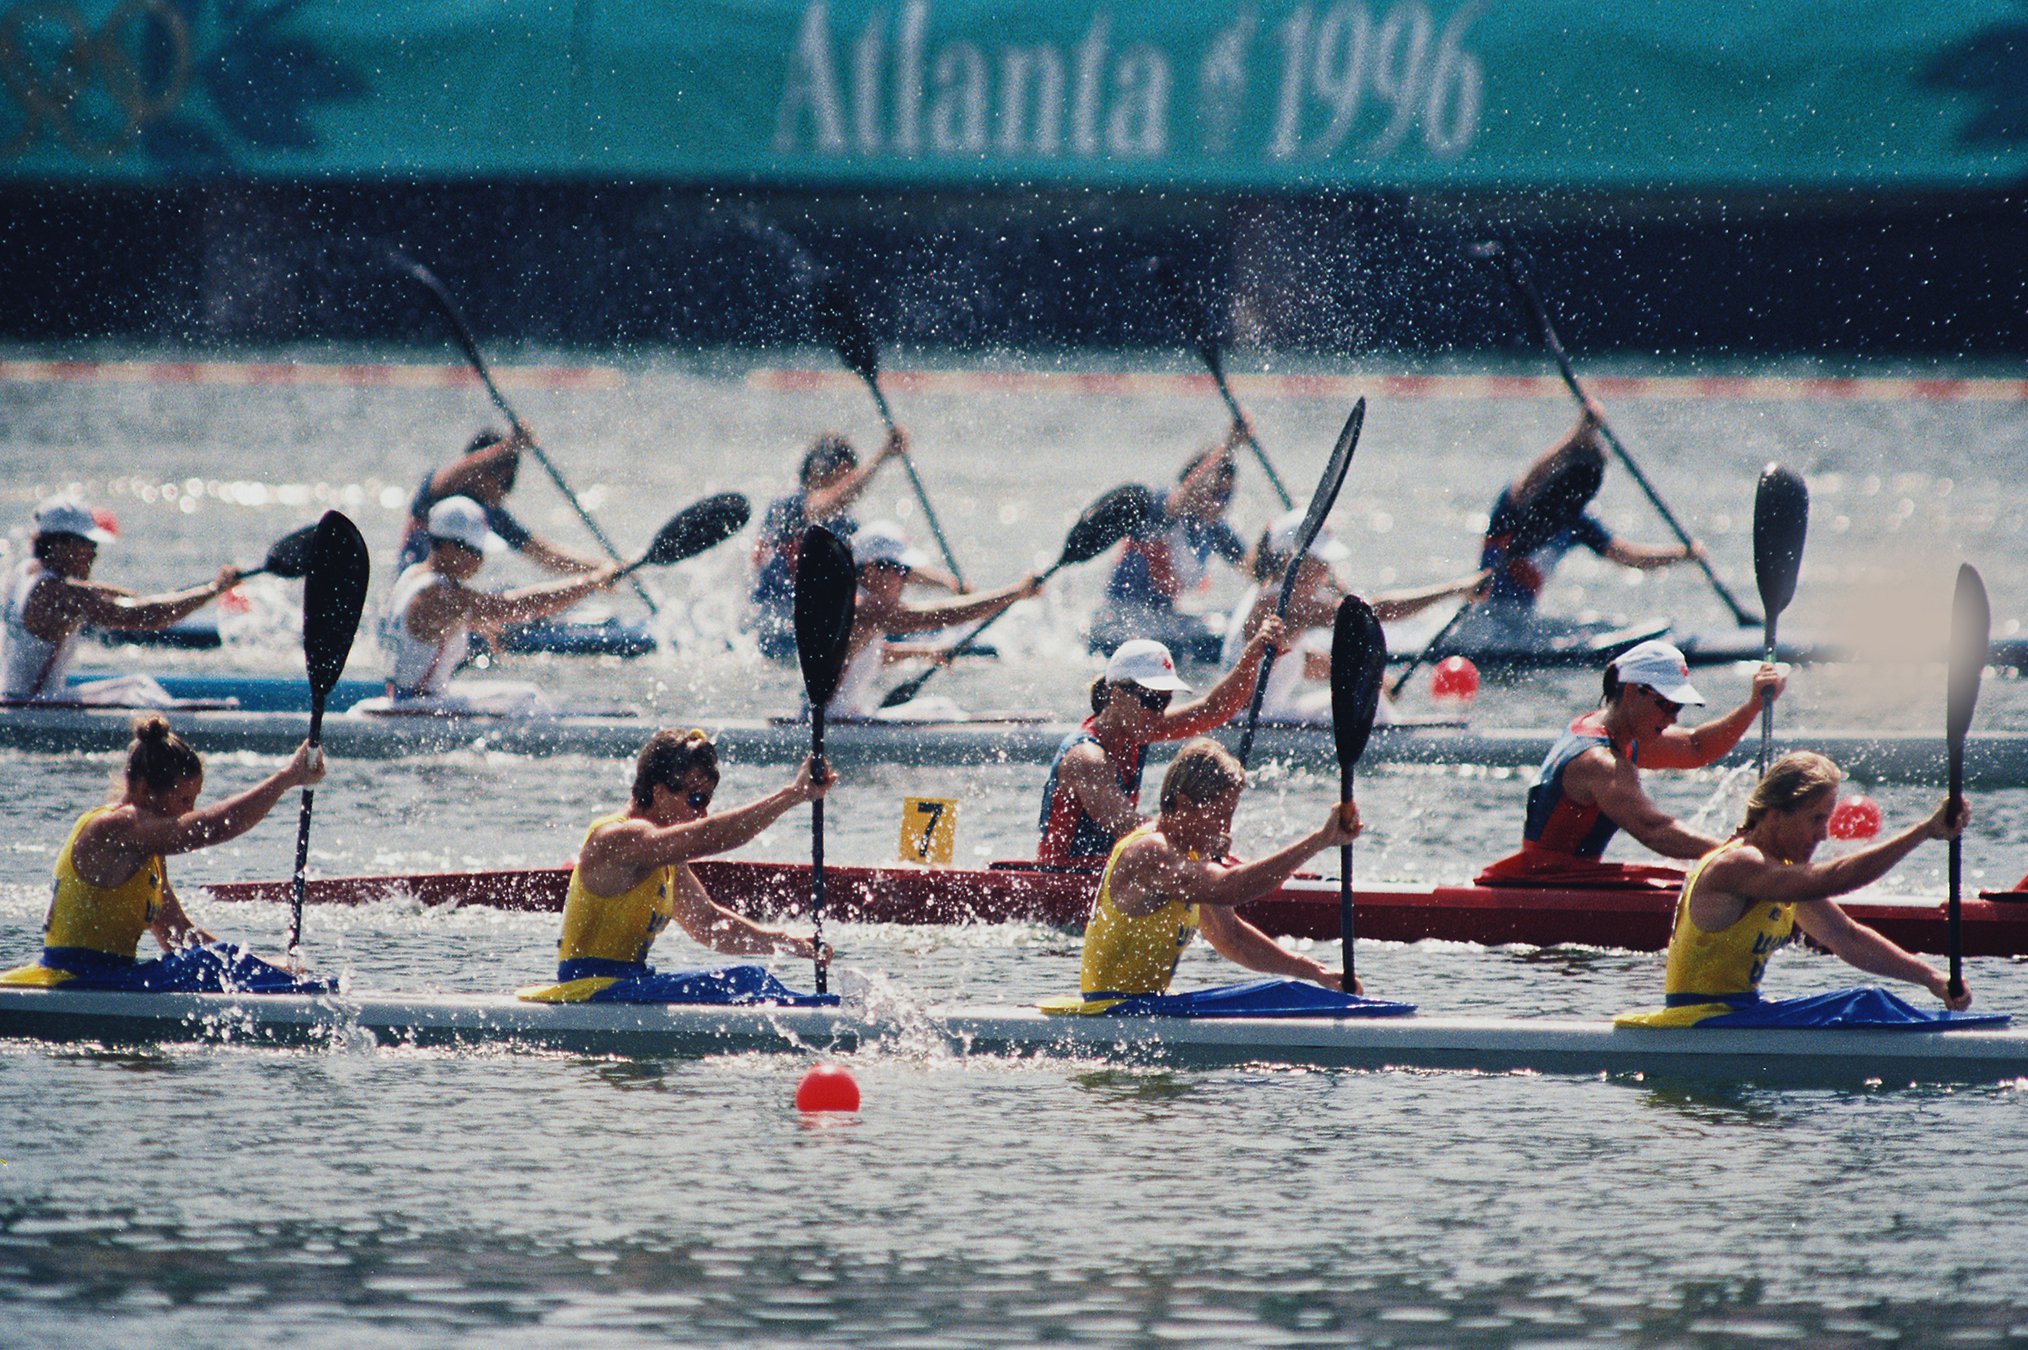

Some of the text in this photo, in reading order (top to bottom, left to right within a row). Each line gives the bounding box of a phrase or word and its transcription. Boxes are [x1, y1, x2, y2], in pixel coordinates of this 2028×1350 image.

[770, 0, 1486, 162] Atlanta 1996
[917, 801, 944, 858] 7
